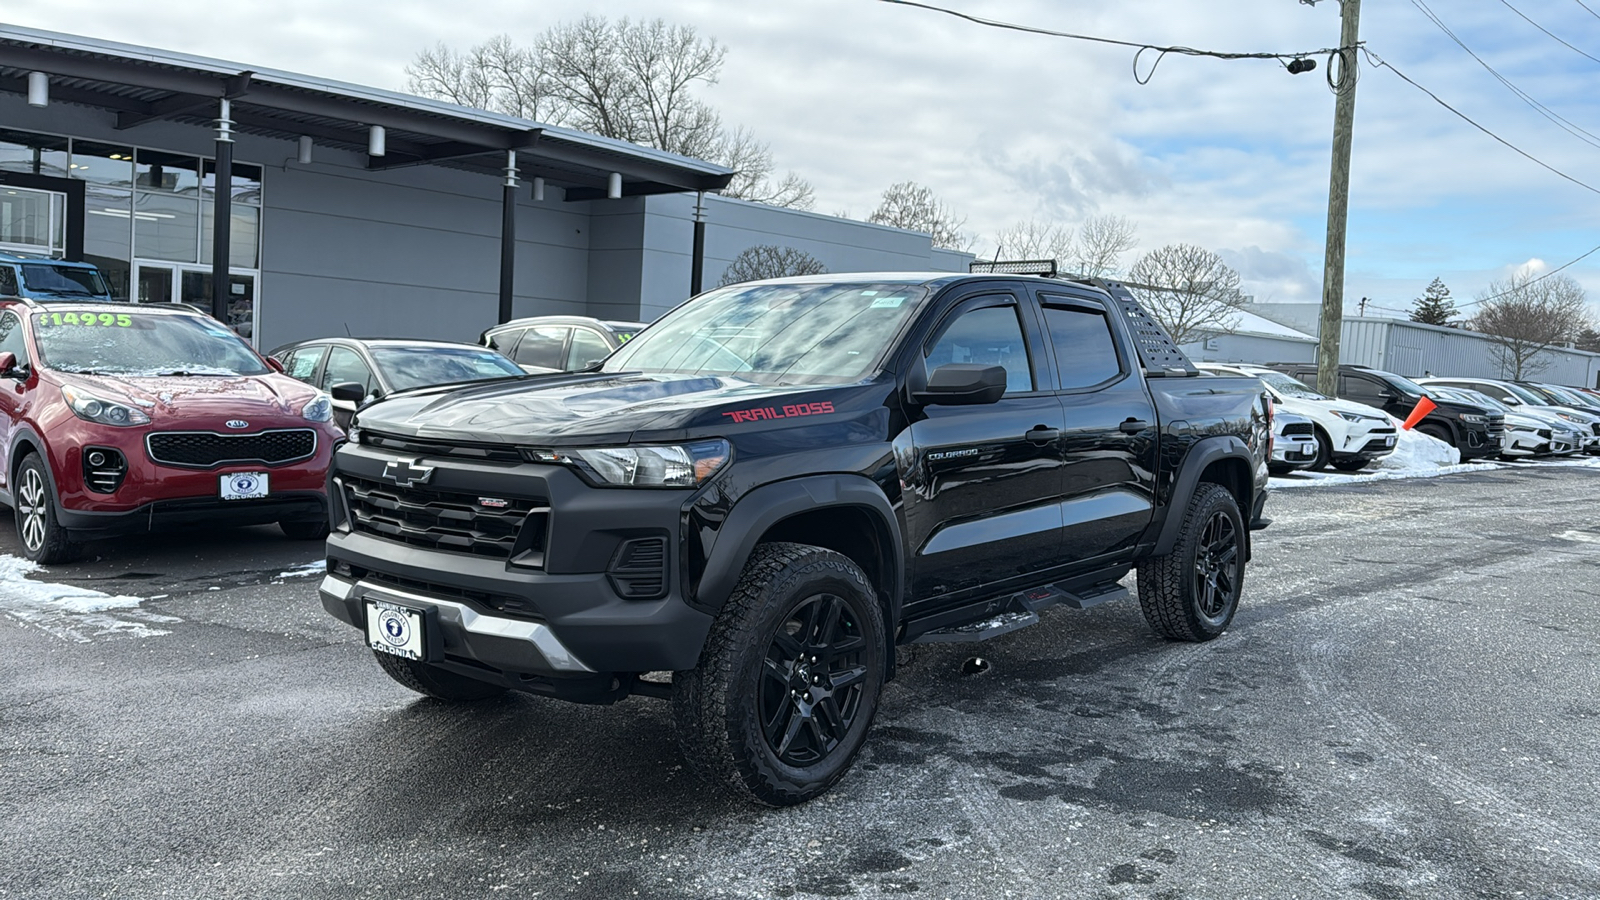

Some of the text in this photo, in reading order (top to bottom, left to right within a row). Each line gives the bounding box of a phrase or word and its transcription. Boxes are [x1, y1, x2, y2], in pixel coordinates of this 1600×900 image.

[40, 312, 132, 327] $14995
[929, 449, 978, 460] COLORADO
[382, 611, 406, 627] COLONIAL
[386, 633, 405, 643] MAZDA
[371, 642, 417, 660] COLONIAL
